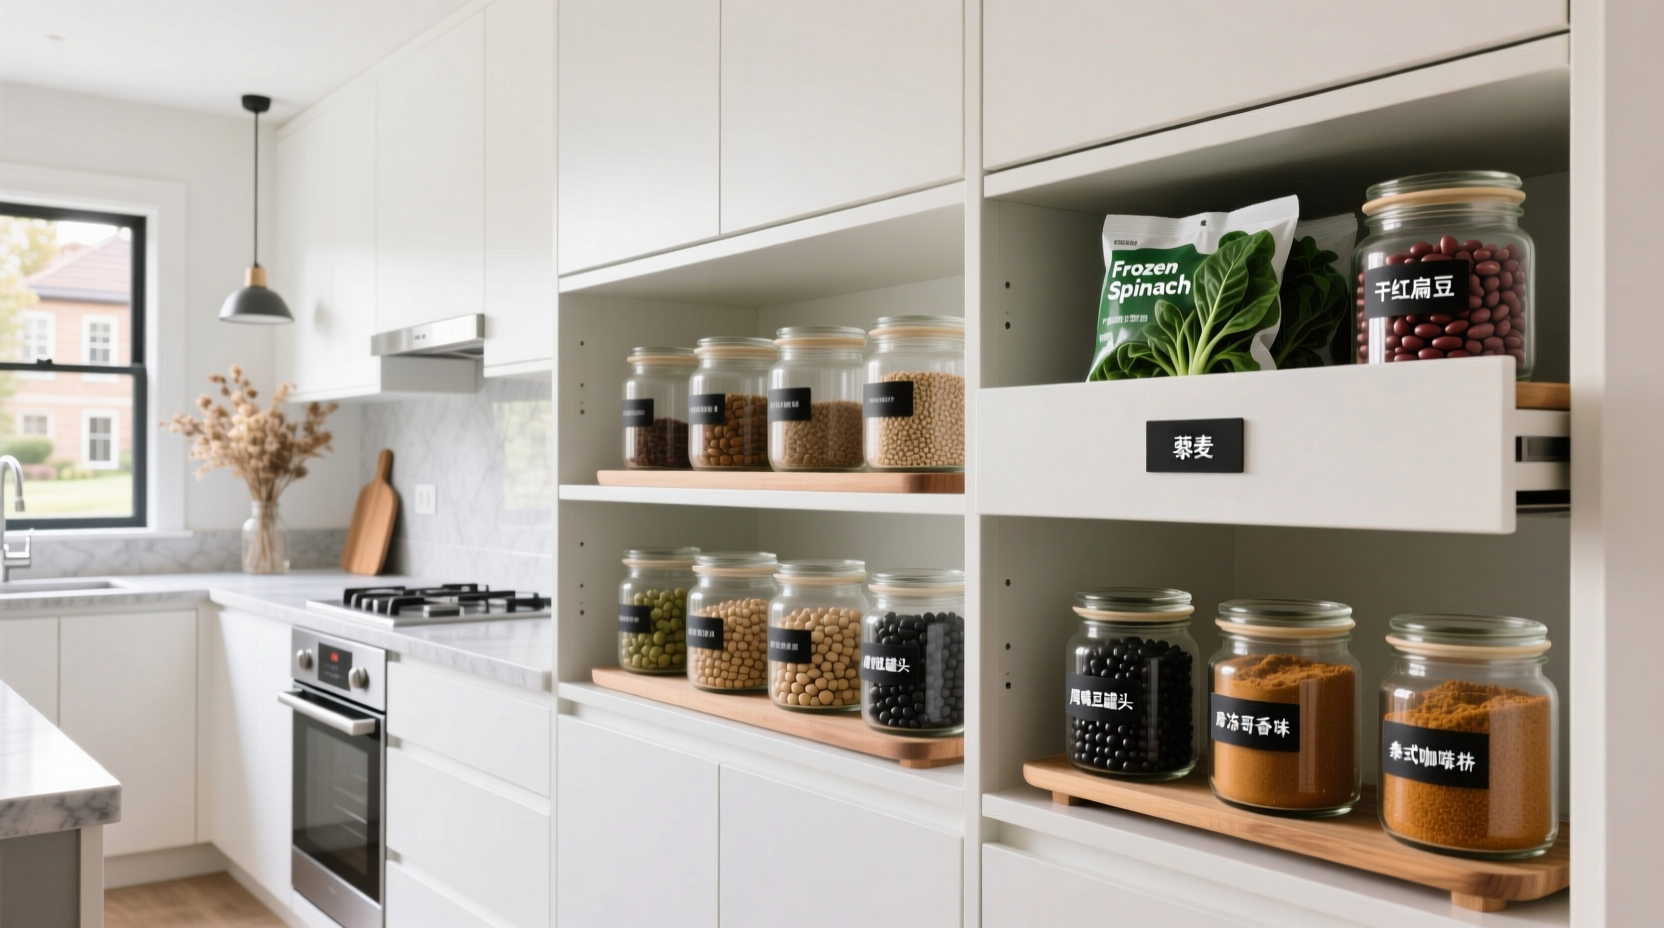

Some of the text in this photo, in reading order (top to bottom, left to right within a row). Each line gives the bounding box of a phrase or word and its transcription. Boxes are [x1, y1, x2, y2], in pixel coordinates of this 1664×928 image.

[1112, 260, 1179, 279] Frozen
[1107, 274, 1192, 304] Spinach
[1374, 275, 1455, 303] 干红扁豆
